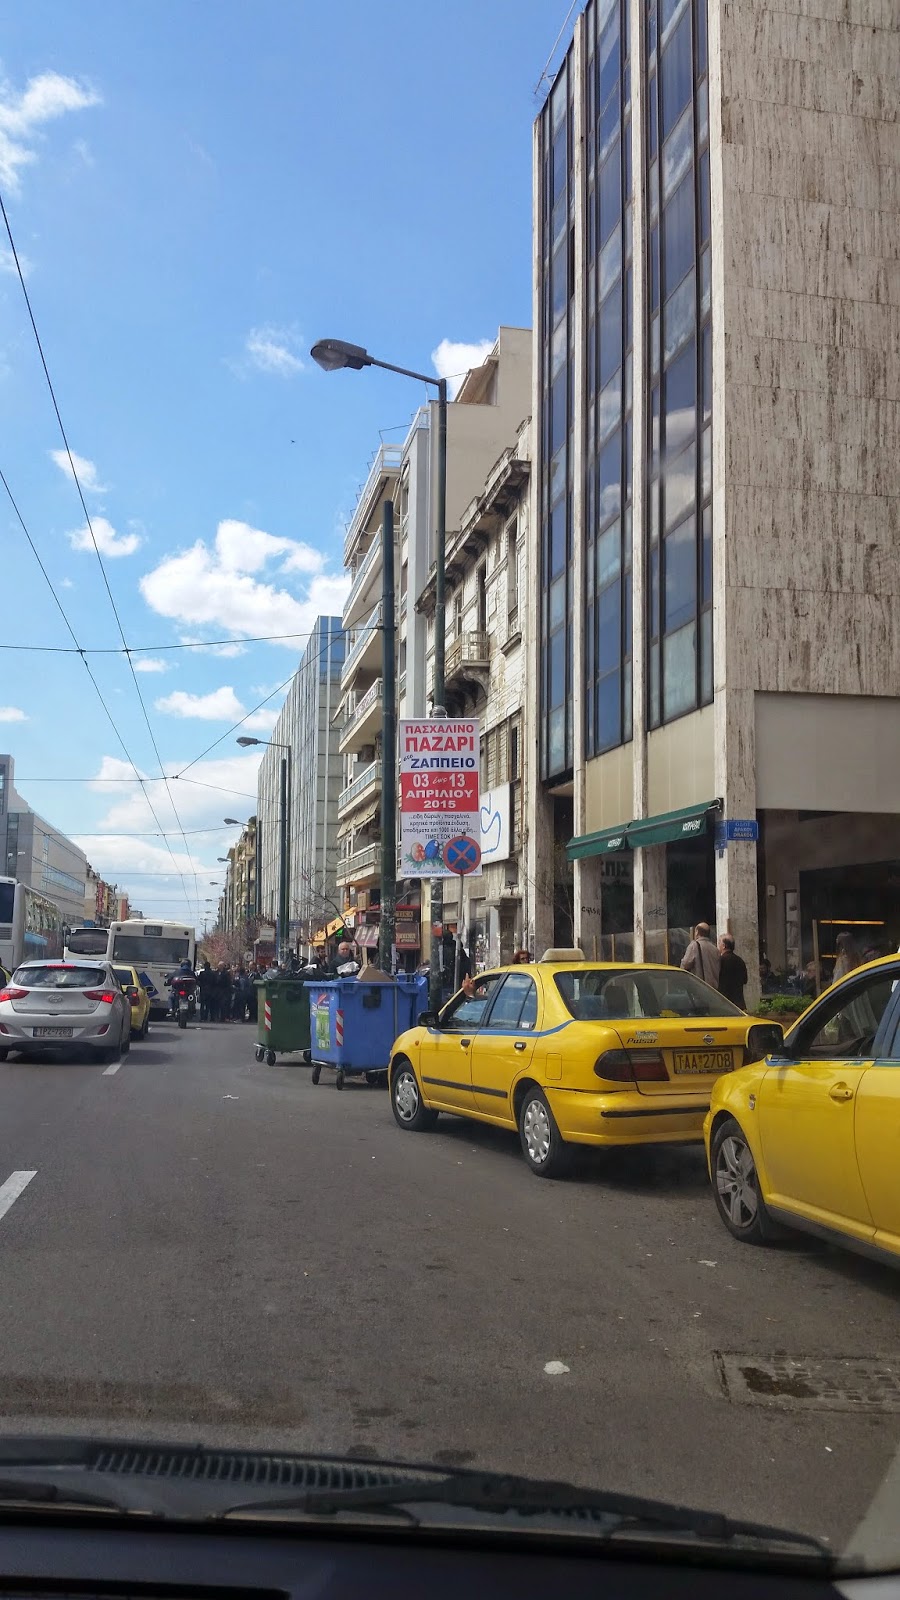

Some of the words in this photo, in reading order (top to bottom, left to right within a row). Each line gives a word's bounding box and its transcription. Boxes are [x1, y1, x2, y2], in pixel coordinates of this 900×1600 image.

[405, 725, 474, 734] ΠΑΣΧΑΛΙΝΟ
[405, 736, 474, 752] ΠΑΖΑΡΙ
[410, 757, 475, 769] ΖΑΠΠΕΙΟ
[412, 773, 430, 788] 03
[449, 773, 466, 788] 13
[405, 789, 474, 799] ΑΠΡΙΛΙΟΥ
[423, 800, 457, 809] 2015
